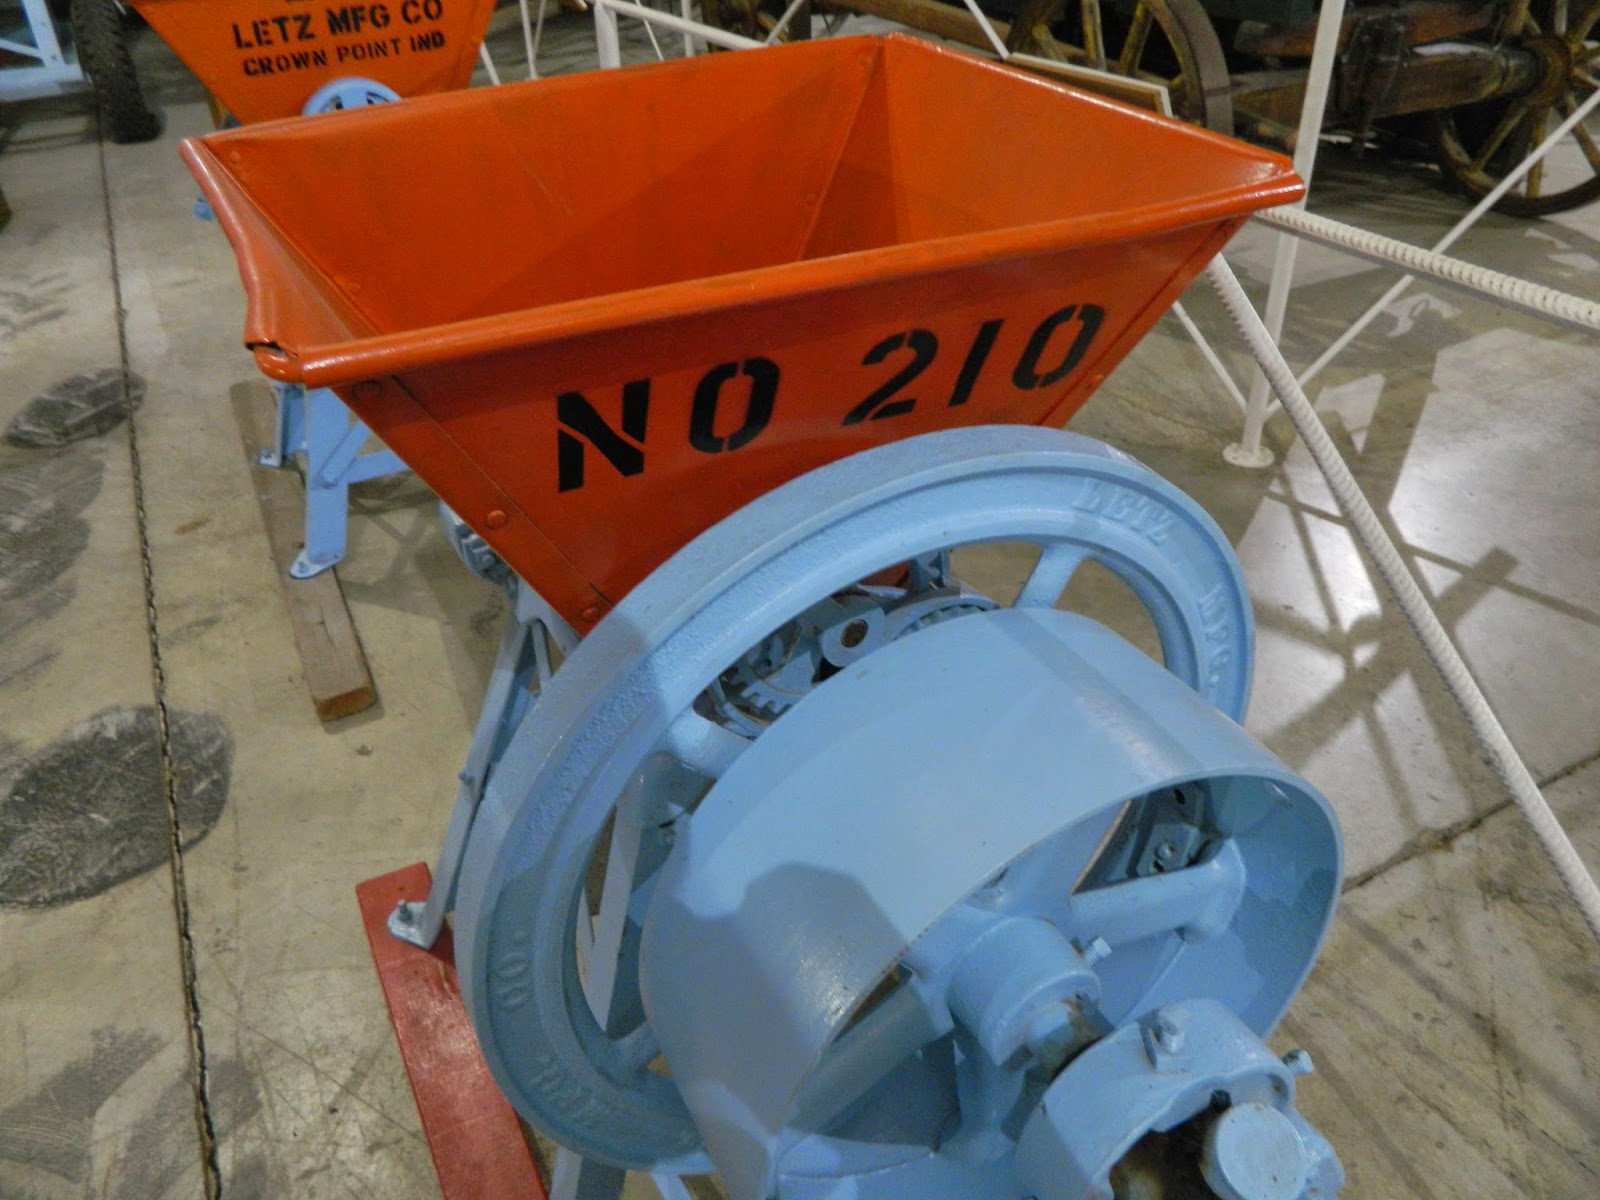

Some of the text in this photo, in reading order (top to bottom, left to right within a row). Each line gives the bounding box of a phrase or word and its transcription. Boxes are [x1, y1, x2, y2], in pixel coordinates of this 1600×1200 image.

[232, 0, 443, 49] LETZ MFG CO
[243, 31, 445, 77] CROWN POINT IND
[557, 304, 1105, 493] NO 210
